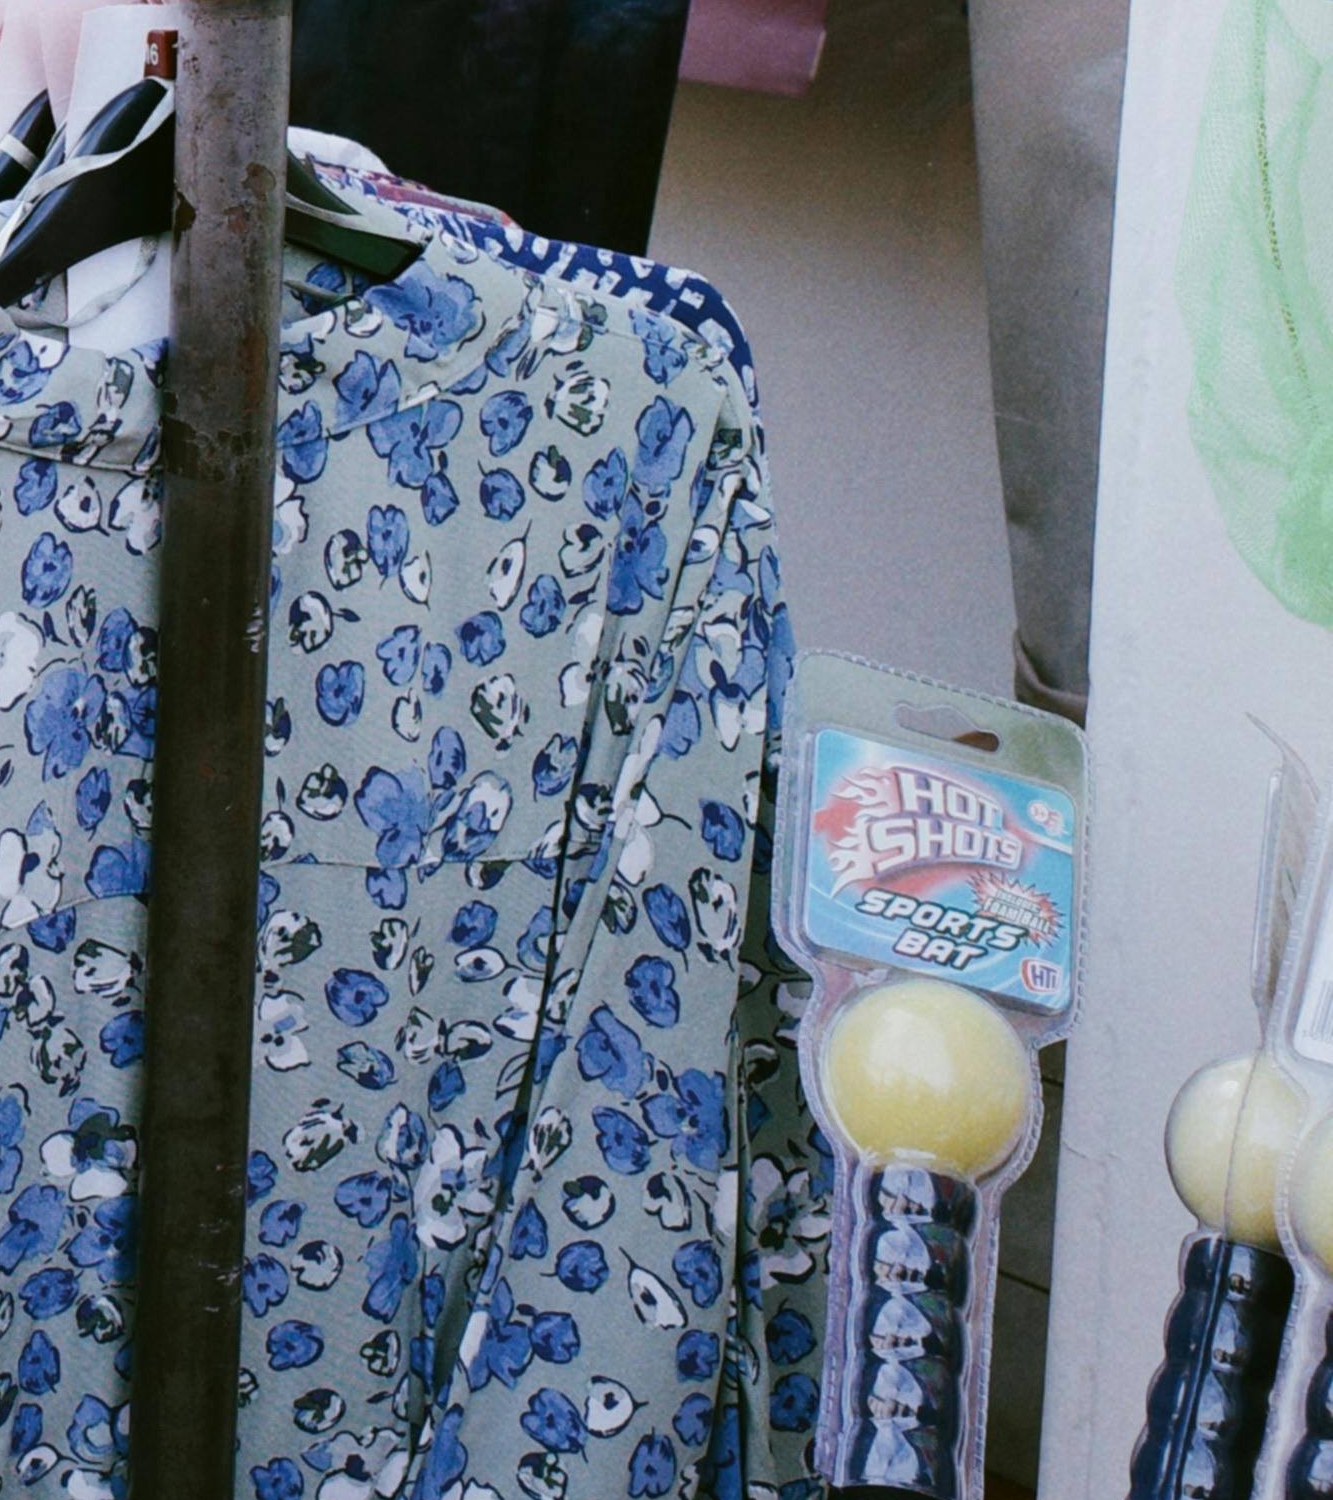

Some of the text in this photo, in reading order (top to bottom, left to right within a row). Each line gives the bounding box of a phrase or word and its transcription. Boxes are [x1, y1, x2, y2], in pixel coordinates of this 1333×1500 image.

[896, 771, 1004, 830] HOT
[871, 816, 1023, 871] SHOTS
[858, 888, 1032, 950] SPORTS
[983, 897, 1020, 925] FOAM
[894, 928, 986, 969] BAT
